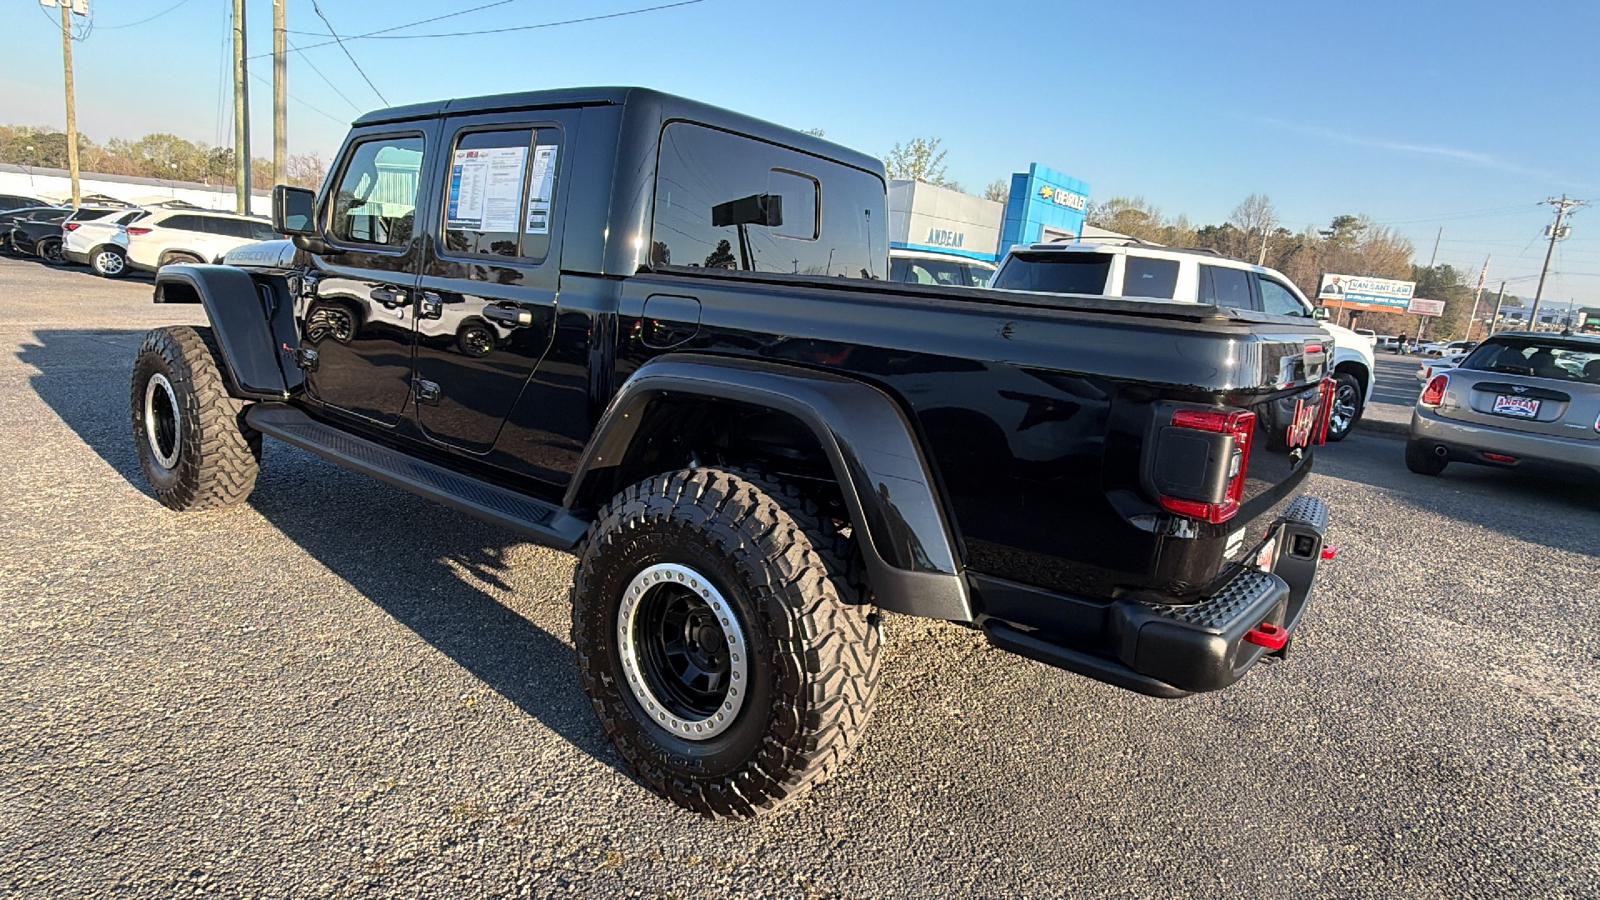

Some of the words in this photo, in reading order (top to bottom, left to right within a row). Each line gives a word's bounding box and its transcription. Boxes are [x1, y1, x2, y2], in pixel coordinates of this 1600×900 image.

[1054, 188, 1087, 210] CHEVROLET
[925, 227, 964, 248] ANDEAN
[1370, 283, 1390, 291] SANT
[1497, 398, 1537, 413] ANDEAN
